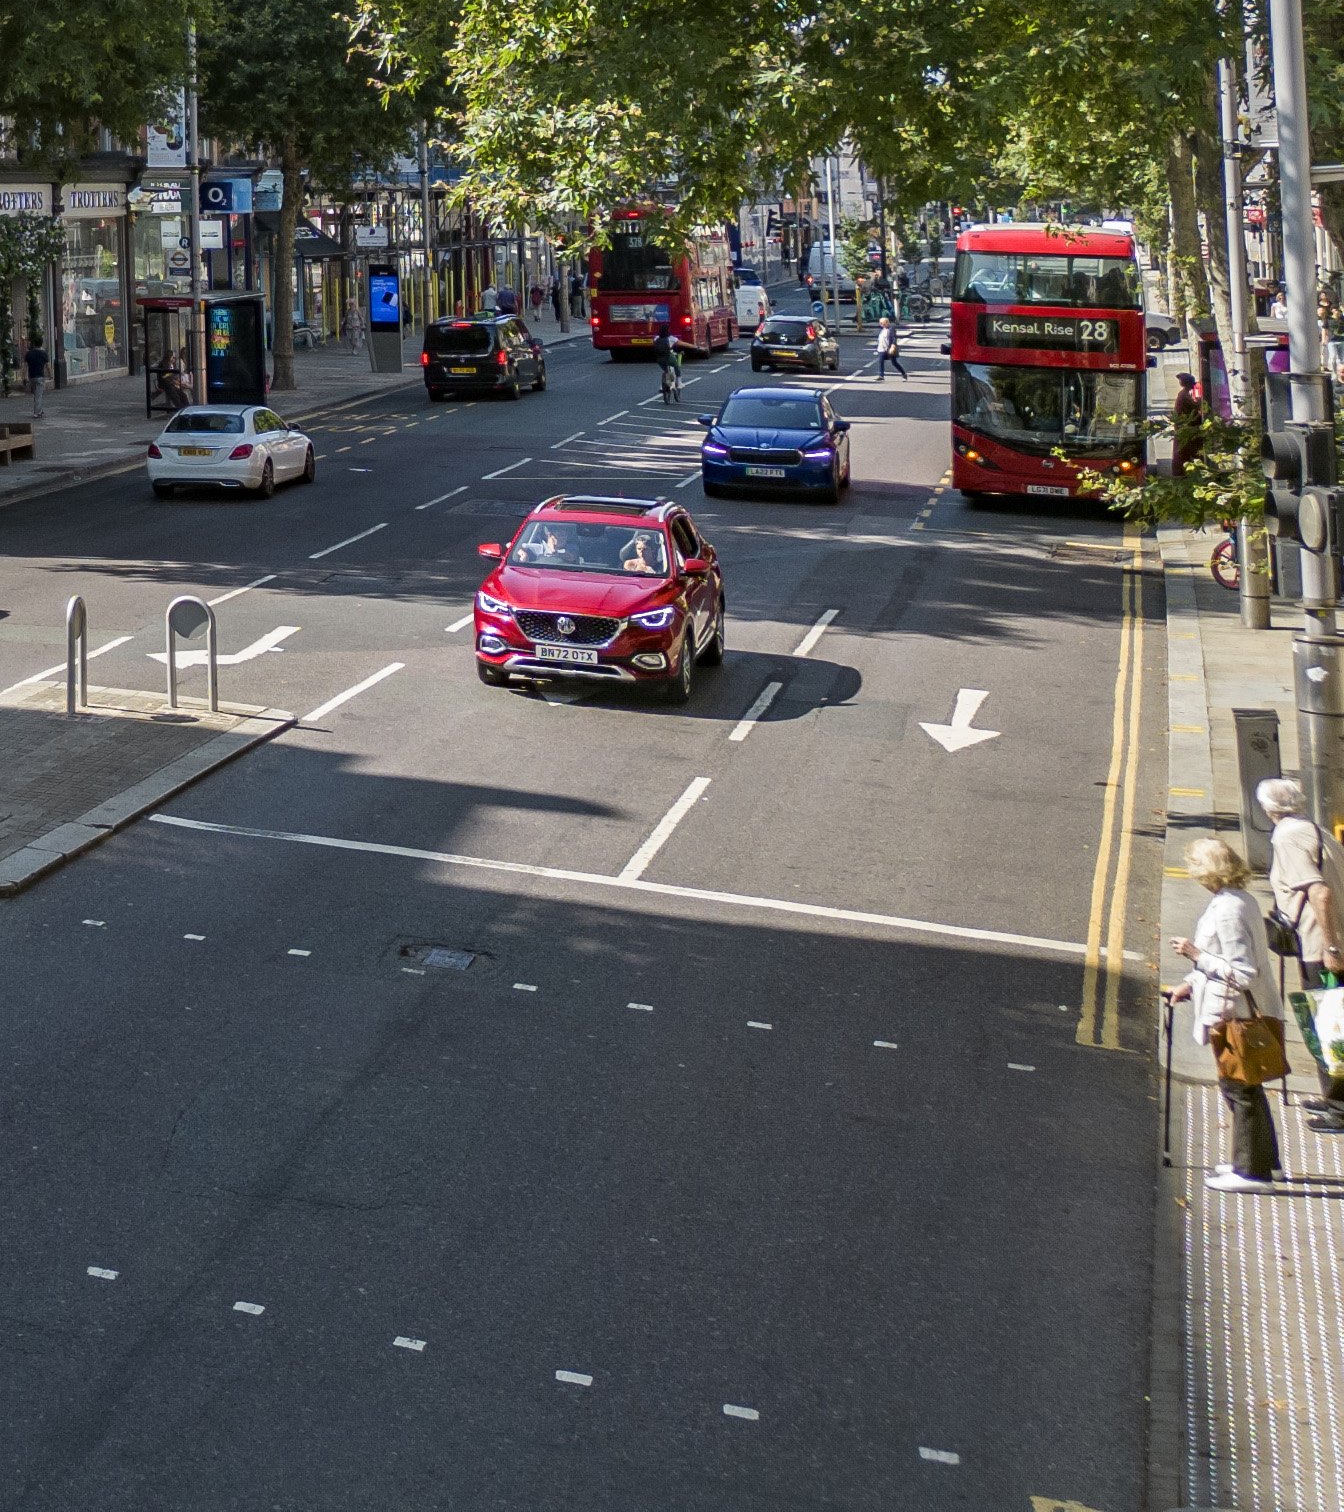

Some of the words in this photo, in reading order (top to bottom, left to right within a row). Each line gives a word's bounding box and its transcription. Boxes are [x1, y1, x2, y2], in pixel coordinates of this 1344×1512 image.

[70, 190, 119, 208] TROTTERS
[992, 320, 1040, 334] Kensal
[1044, 322, 1074, 336] Rise
[1079, 320, 1108, 341] 28
[540, 647, 569, 659] BN72
